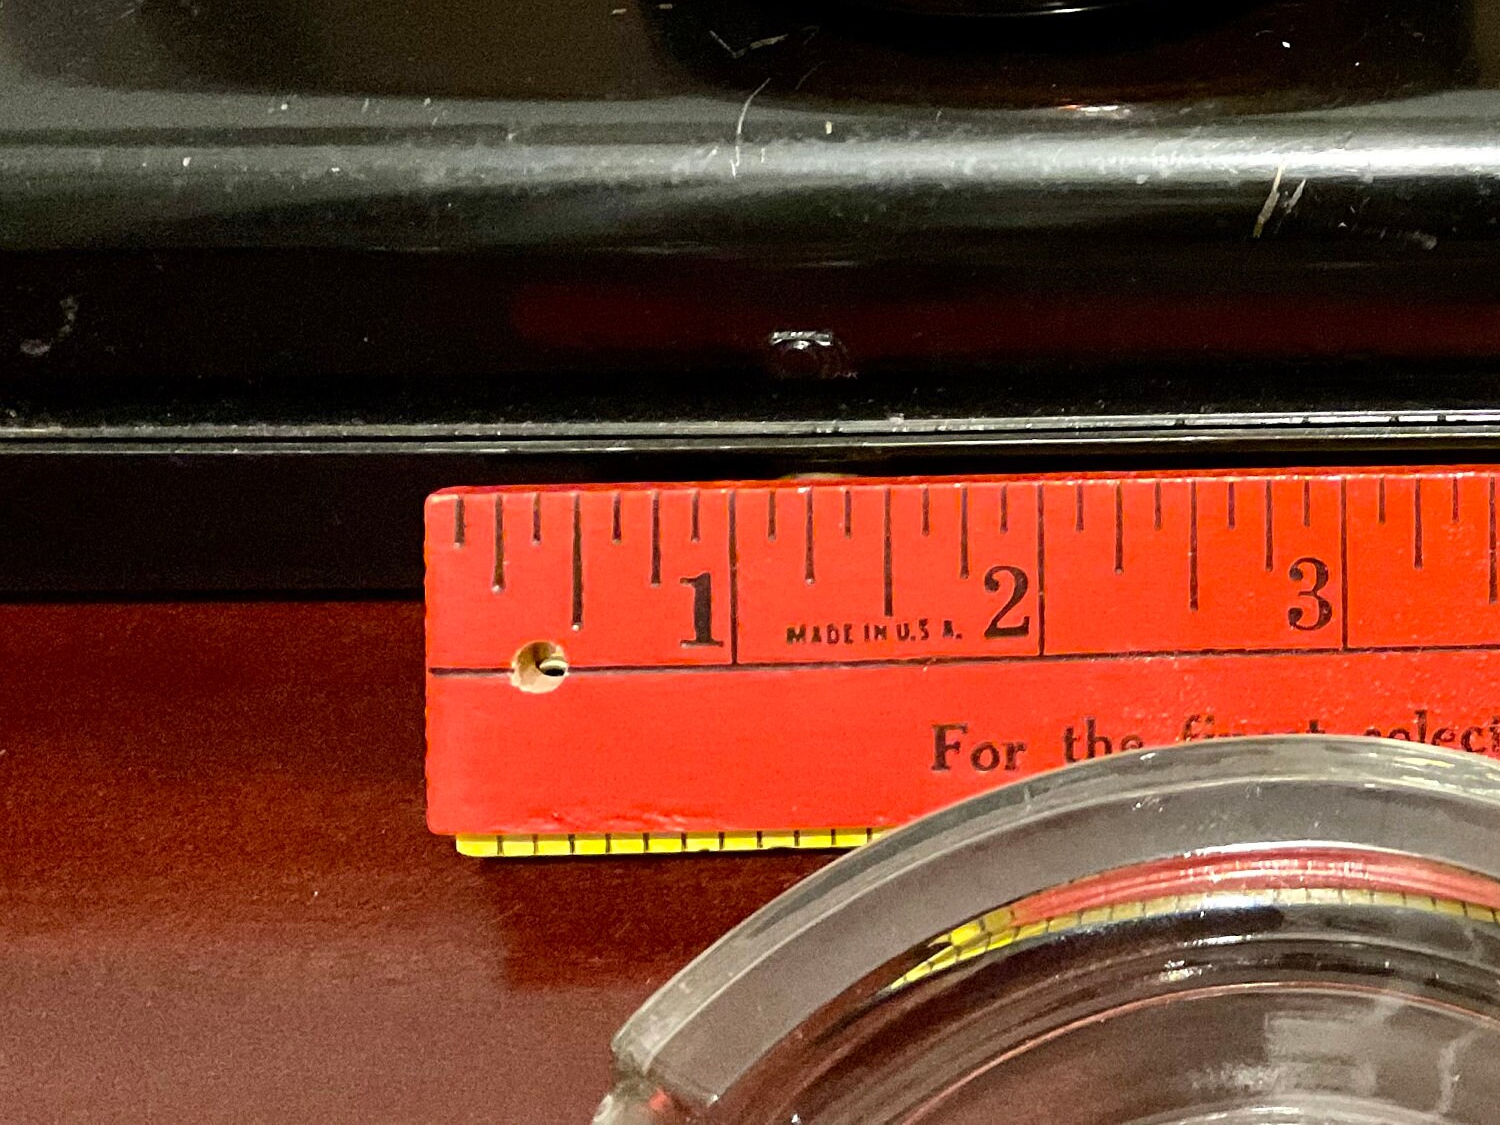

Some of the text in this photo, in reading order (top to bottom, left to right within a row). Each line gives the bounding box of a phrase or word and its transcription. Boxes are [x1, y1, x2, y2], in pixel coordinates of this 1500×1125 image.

[680, 572, 724, 647] 1
[984, 565, 1030, 639] 2
[1288, 557, 1333, 631] 3
[786, 618, 962, 645] MADE IN U.SA.
[931, 723, 1026, 771] For
